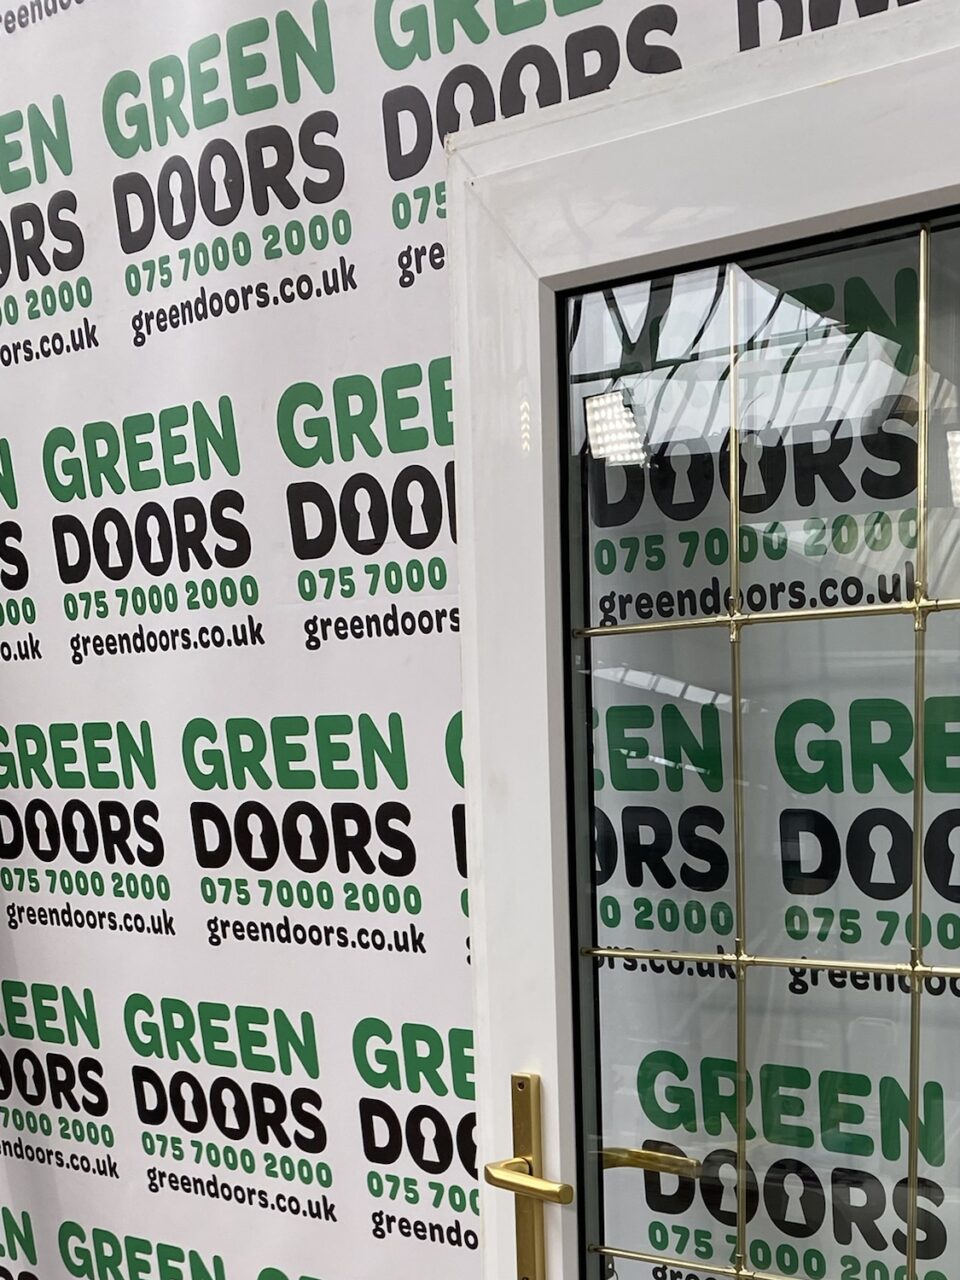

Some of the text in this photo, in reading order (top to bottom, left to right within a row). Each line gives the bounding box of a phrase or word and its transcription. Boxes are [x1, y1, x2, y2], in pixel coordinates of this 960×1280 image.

[103, 0, 335, 158] GREEN
[114, 111, 344, 254] DOORS
[126, 210, 351, 296] 075 7000 2000
[26, 277, 92, 320] 2000
[132, 256, 357, 346] greendoors.co.uk
[43, 396, 240, 502] GREEN
[52, 490, 251, 584] DOORS
[287, 461, 457, 560] DOO
[594, 507, 916, 576] 075 7000 2000
[64, 575, 258, 620] 075 7000 2000
[298, 557, 447, 601] 075 7000
[71, 615, 265, 664] greendoors.co.uk
[182, 713, 408, 790] GREEN
[0, 799, 164, 867] DOORS
[190, 801, 416, 876] DOORS
[0, 867, 170, 901] 075 7000 2000
[201, 877, 421, 914] 075 7000 2000
[7, 902, 175, 935] greendoors.co.uk
[207, 916, 426, 953] greendoors.co.uk
[633, 896, 735, 936] 2000
[784, 905, 862, 944] 075
[0, 980, 100, 1049] EEN
[124, 993, 319, 1079] GREEN
[0, 1106, 114, 1147] 7000 2000
[132, 1066, 326, 1153] DOORS
[637, 1050, 945, 1167] GREEN
[2, 1137, 119, 1178] ndoors.co.uk
[142, 1132, 332, 1187] 075 7000 2000
[367, 1171, 419, 1204] 075
[147, 1167, 337, 1222] greendoors.co.uk
[642, 1140, 948, 1260] DOORS
[648, 1221, 715, 1260] 075
